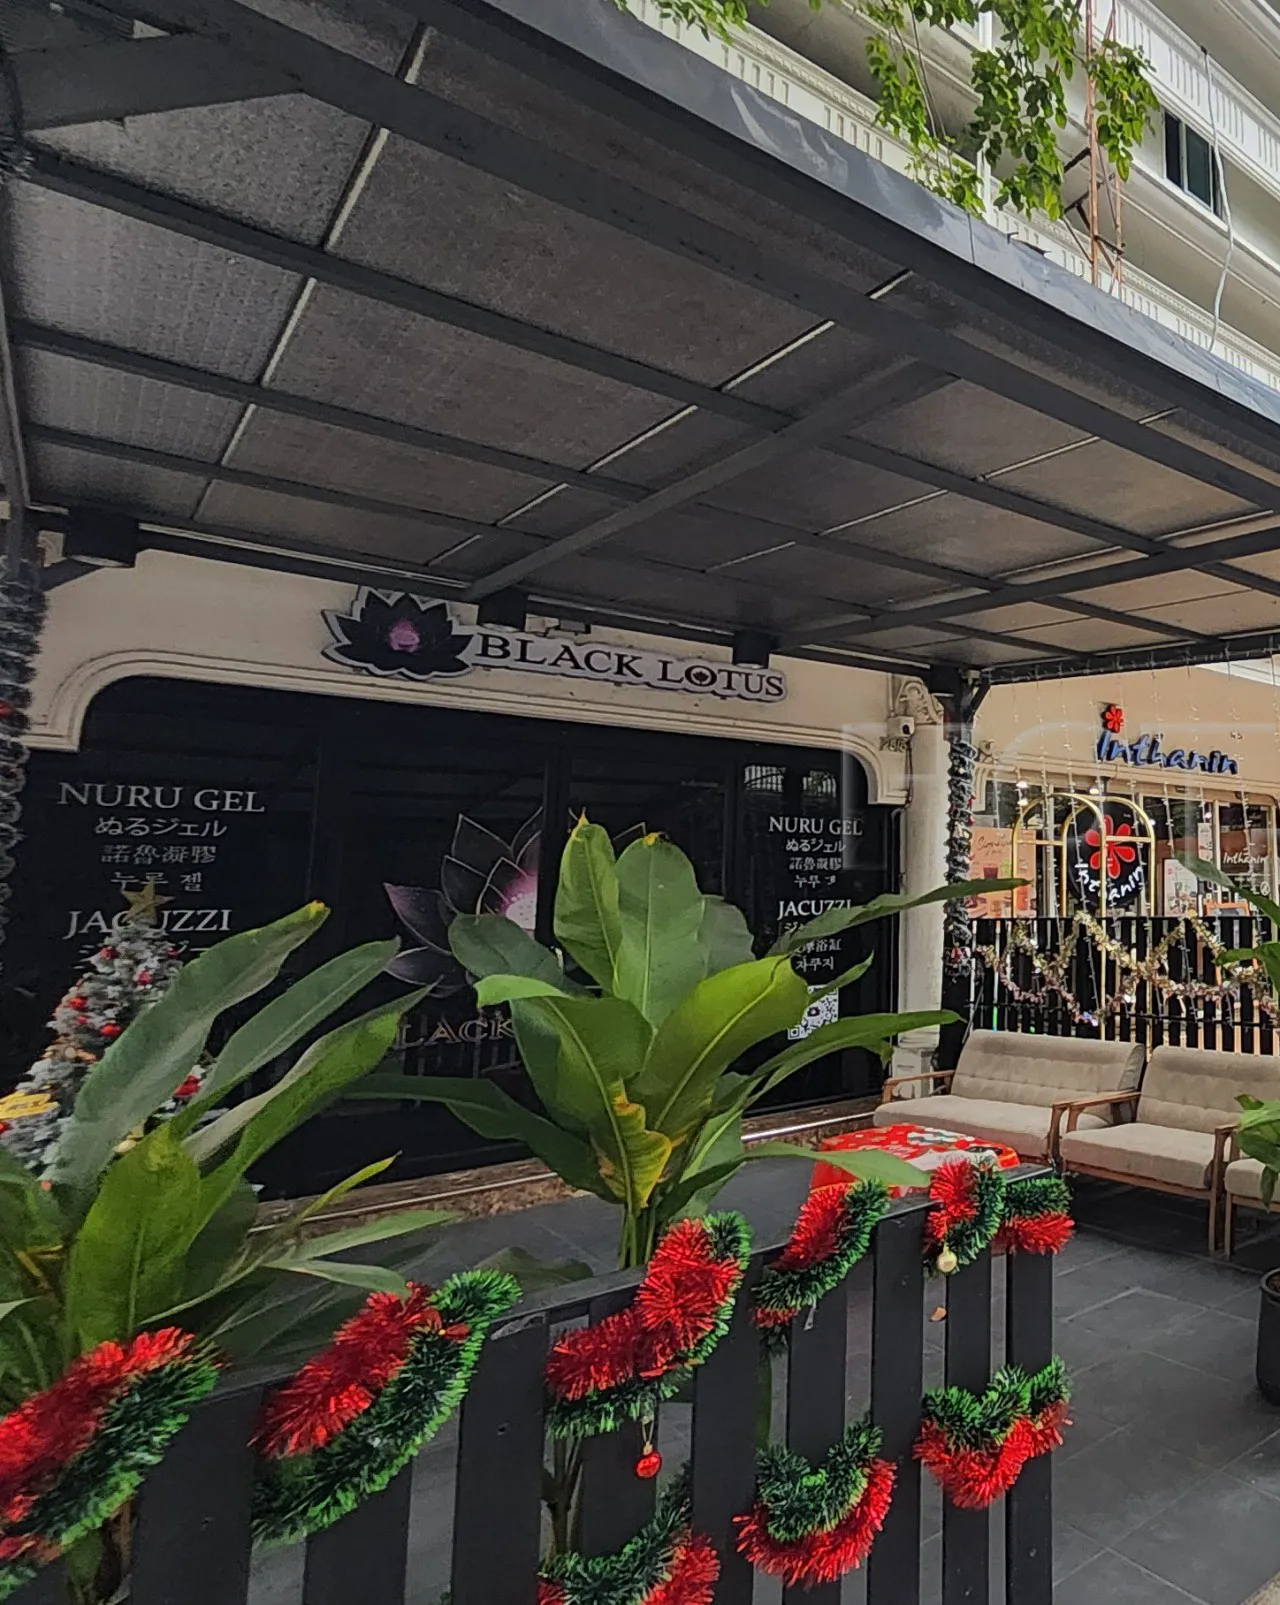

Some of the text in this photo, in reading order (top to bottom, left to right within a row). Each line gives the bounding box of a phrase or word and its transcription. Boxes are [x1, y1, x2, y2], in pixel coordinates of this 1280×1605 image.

[476, 634, 785, 698] BLACK LOTUS
[1094, 729, 1239, 774] Inthanin
[57, 781, 266, 813] NURU GEL
[94, 816, 228, 837] ぬるジェル
[768, 816, 863, 836] NURU GEL
[396, 1015, 514, 1050] LACK
